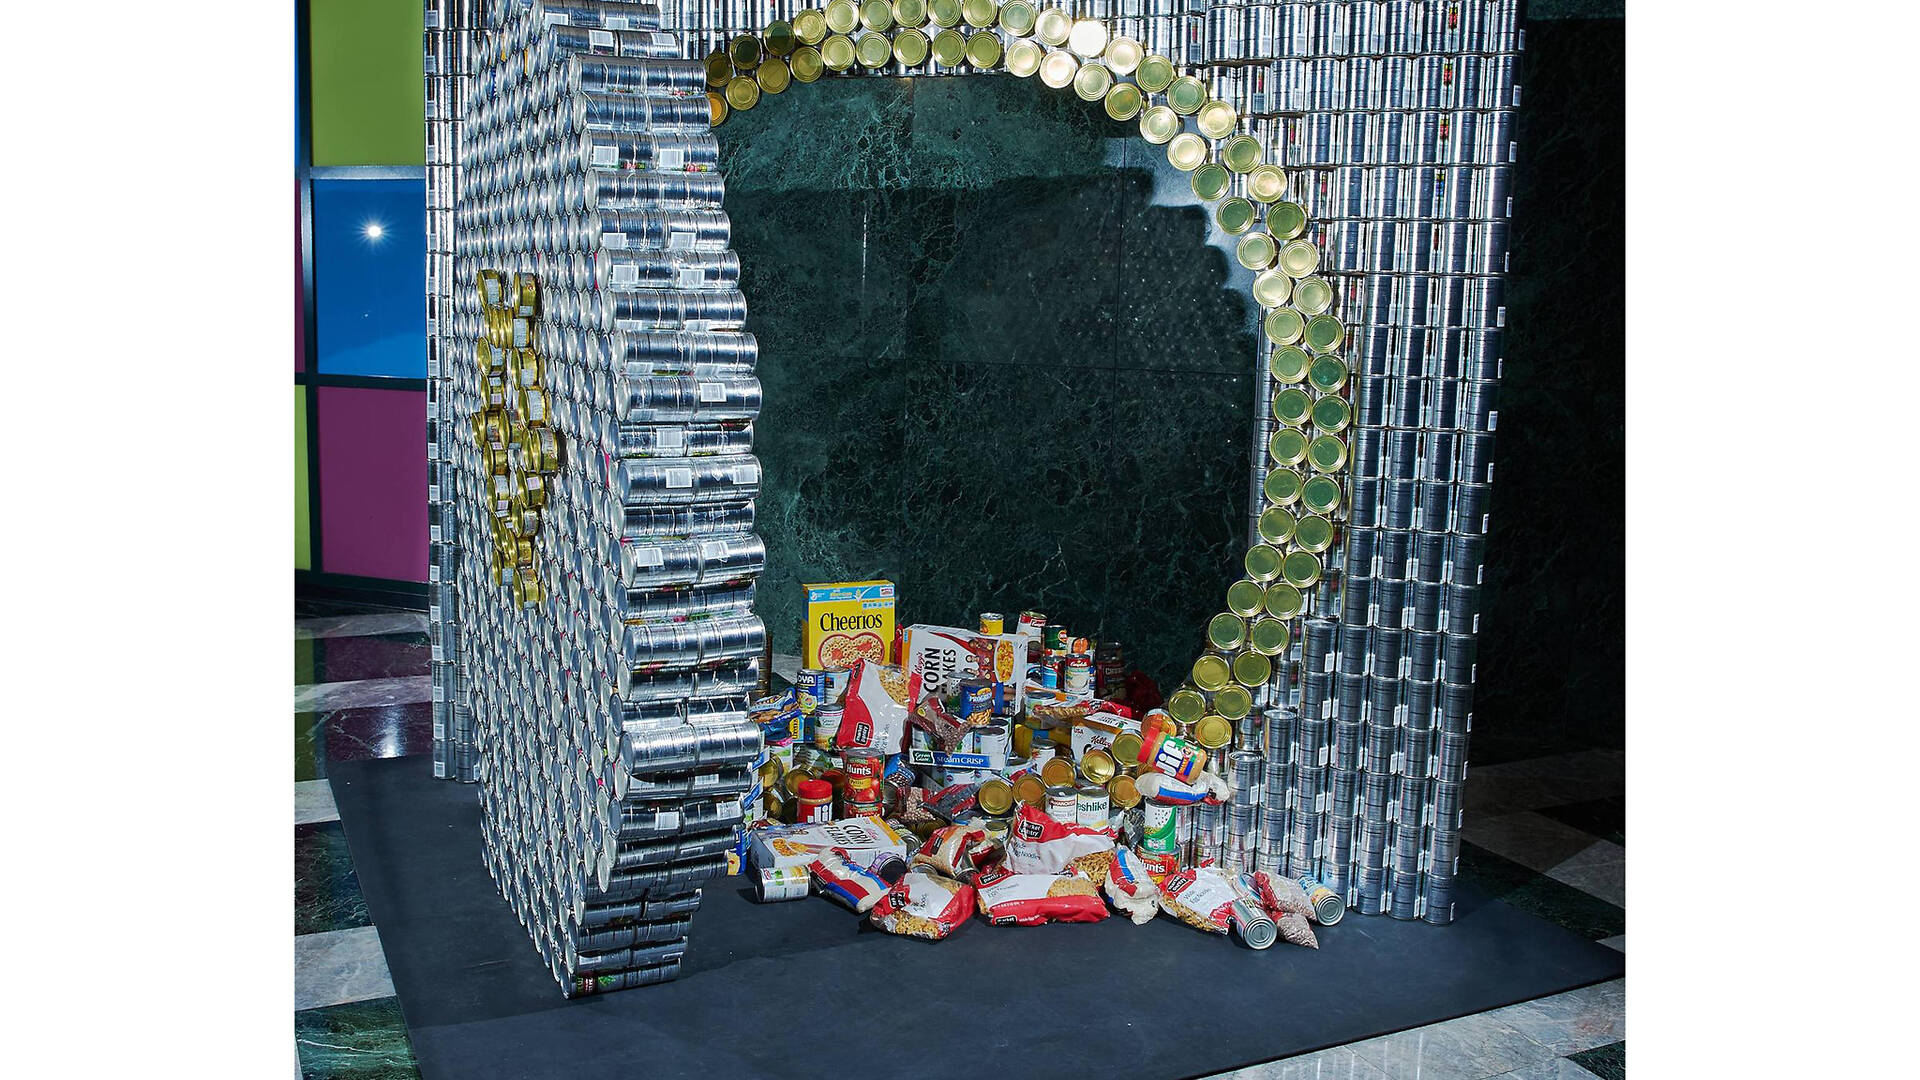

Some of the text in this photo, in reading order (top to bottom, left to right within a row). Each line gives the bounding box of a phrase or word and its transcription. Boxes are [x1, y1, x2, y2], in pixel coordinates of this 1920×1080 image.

[820, 612, 882, 632] Cheerios
[923, 647, 941, 692] CORN
[1155, 739, 1184, 777] Jif
[847, 763, 872, 775] Hunt's
[843, 824, 875, 844] CORN
